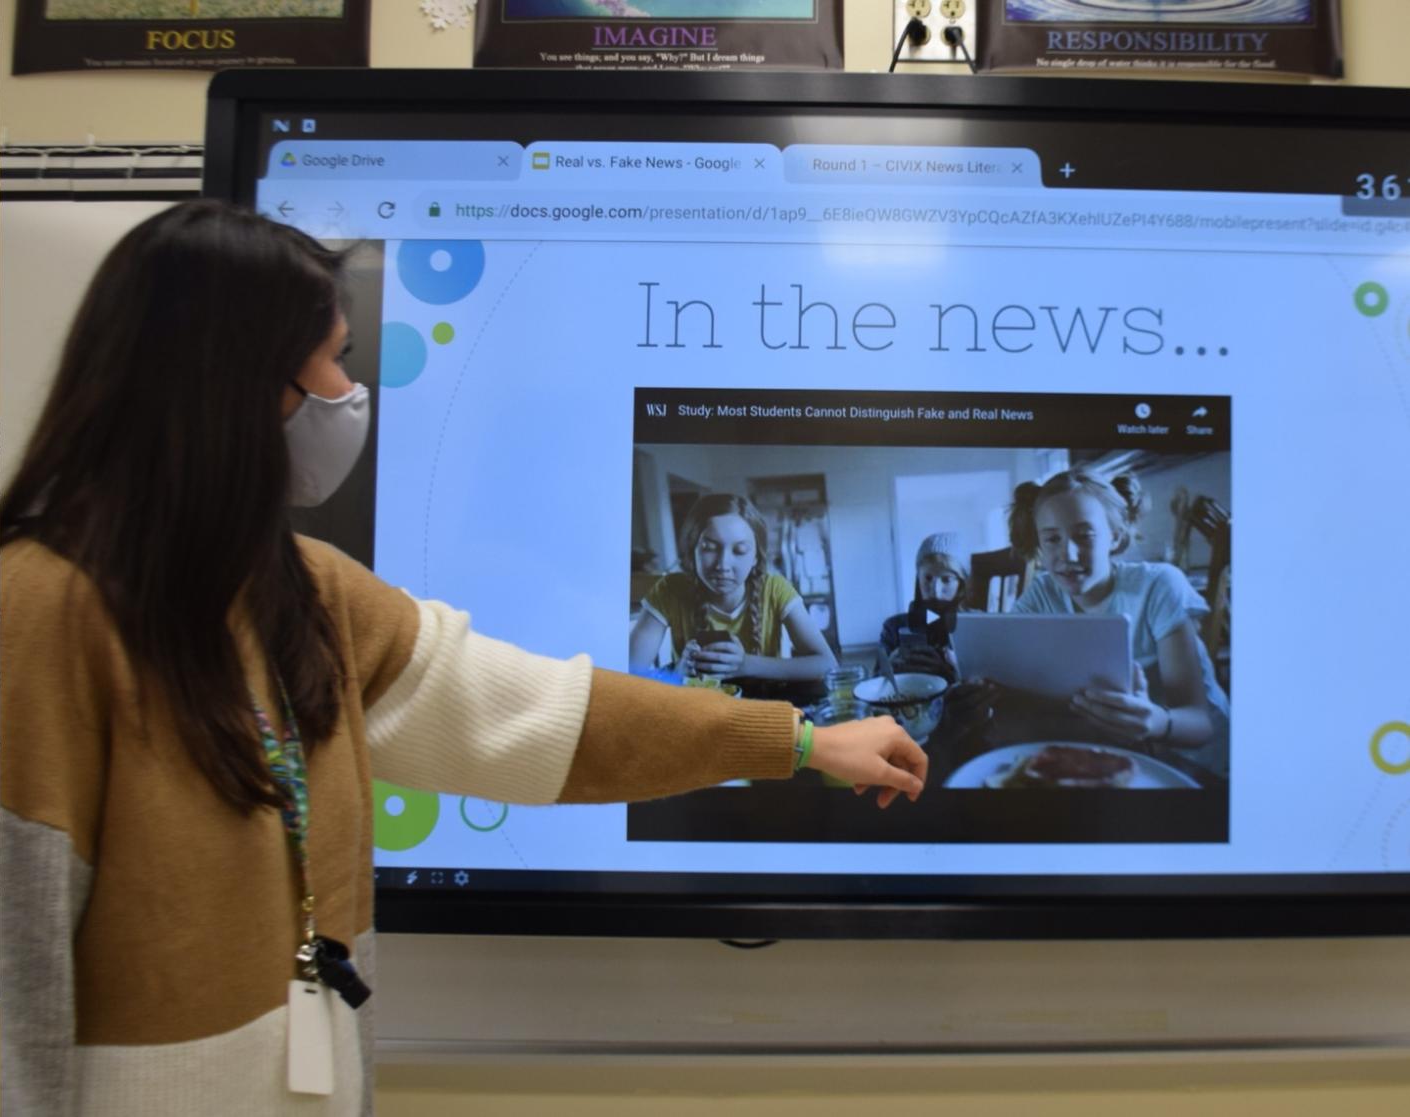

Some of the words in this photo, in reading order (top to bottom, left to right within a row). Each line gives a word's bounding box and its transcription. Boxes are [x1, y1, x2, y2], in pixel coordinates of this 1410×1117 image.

[146, 30, 236, 50] FOCUS
[594, 27, 717, 46] IMAGINE
[1047, 31, 1268, 51] RESPONSIBILITY
[540, 53, 557, 63] You
[559, 53, 572, 63] see
[604, 53, 618, 63] and
[621, 53, 636, 63] you
[690, 52, 704, 63] But
[712, 52, 738, 63] dream
[740, 52, 764, 63] things
[302, 154, 348, 169] Google
[352, 154, 385, 166] Drive
[555, 155, 584, 168] Real
[588, 158, 606, 169] vs.
[610, 156, 641, 169] Fake
[646, 157, 683, 169] News
[813, 158, 856, 171] Round
[861, 160, 867, 171] 1
[885, 160, 921, 172] CIVIX
[926, 161, 963, 173] News
[1356, 172, 1410, 201] 36
[637, 282, 722, 348] In
[752, 283, 897, 351] the
[929, 302, 1229, 356] news...
[646, 403, 667, 416] WSJ
[678, 404, 714, 419] Study:
[717, 405, 747, 417] Most
[750, 405, 801, 418] Students
[805, 406, 846, 418] Cannot
[850, 406, 915, 421] Distinguish
[917, 407, 945, 419] Fake
[948, 408, 969, 420] and
[973, 408, 998, 420] Real
[1001, 409, 1034, 420] News
[1117, 424, 1146, 434] Watch
[1148, 424, 1169, 434] later
[1186, 425, 1213, 435] Share
